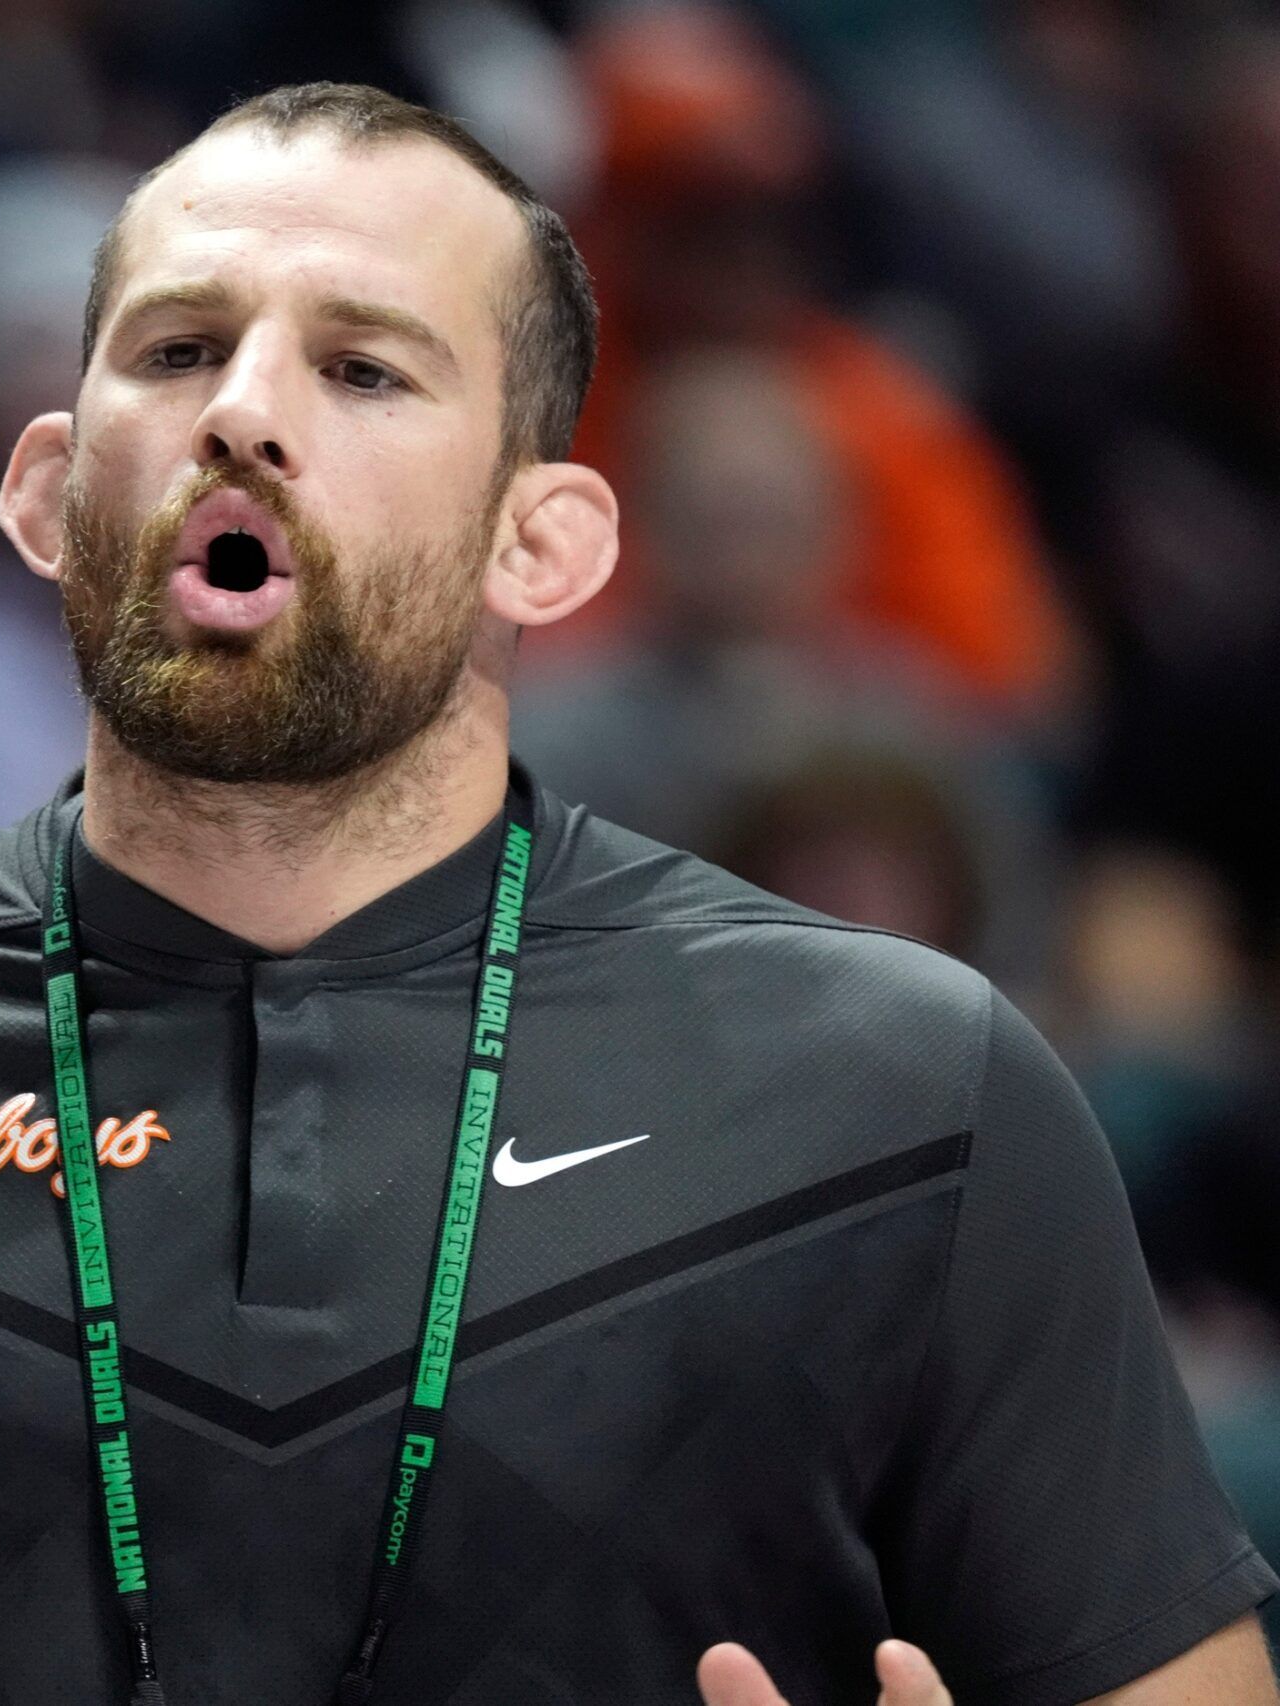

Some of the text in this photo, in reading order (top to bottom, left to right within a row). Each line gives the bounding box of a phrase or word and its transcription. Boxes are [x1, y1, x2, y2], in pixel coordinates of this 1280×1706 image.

[53, 992, 147, 1594] NATIONAL DUALS INVITATIONAL
[422, 822, 532, 1387] NATIONAL DUALS INVITATIONAL
[386, 1467, 417, 1566] paycom
